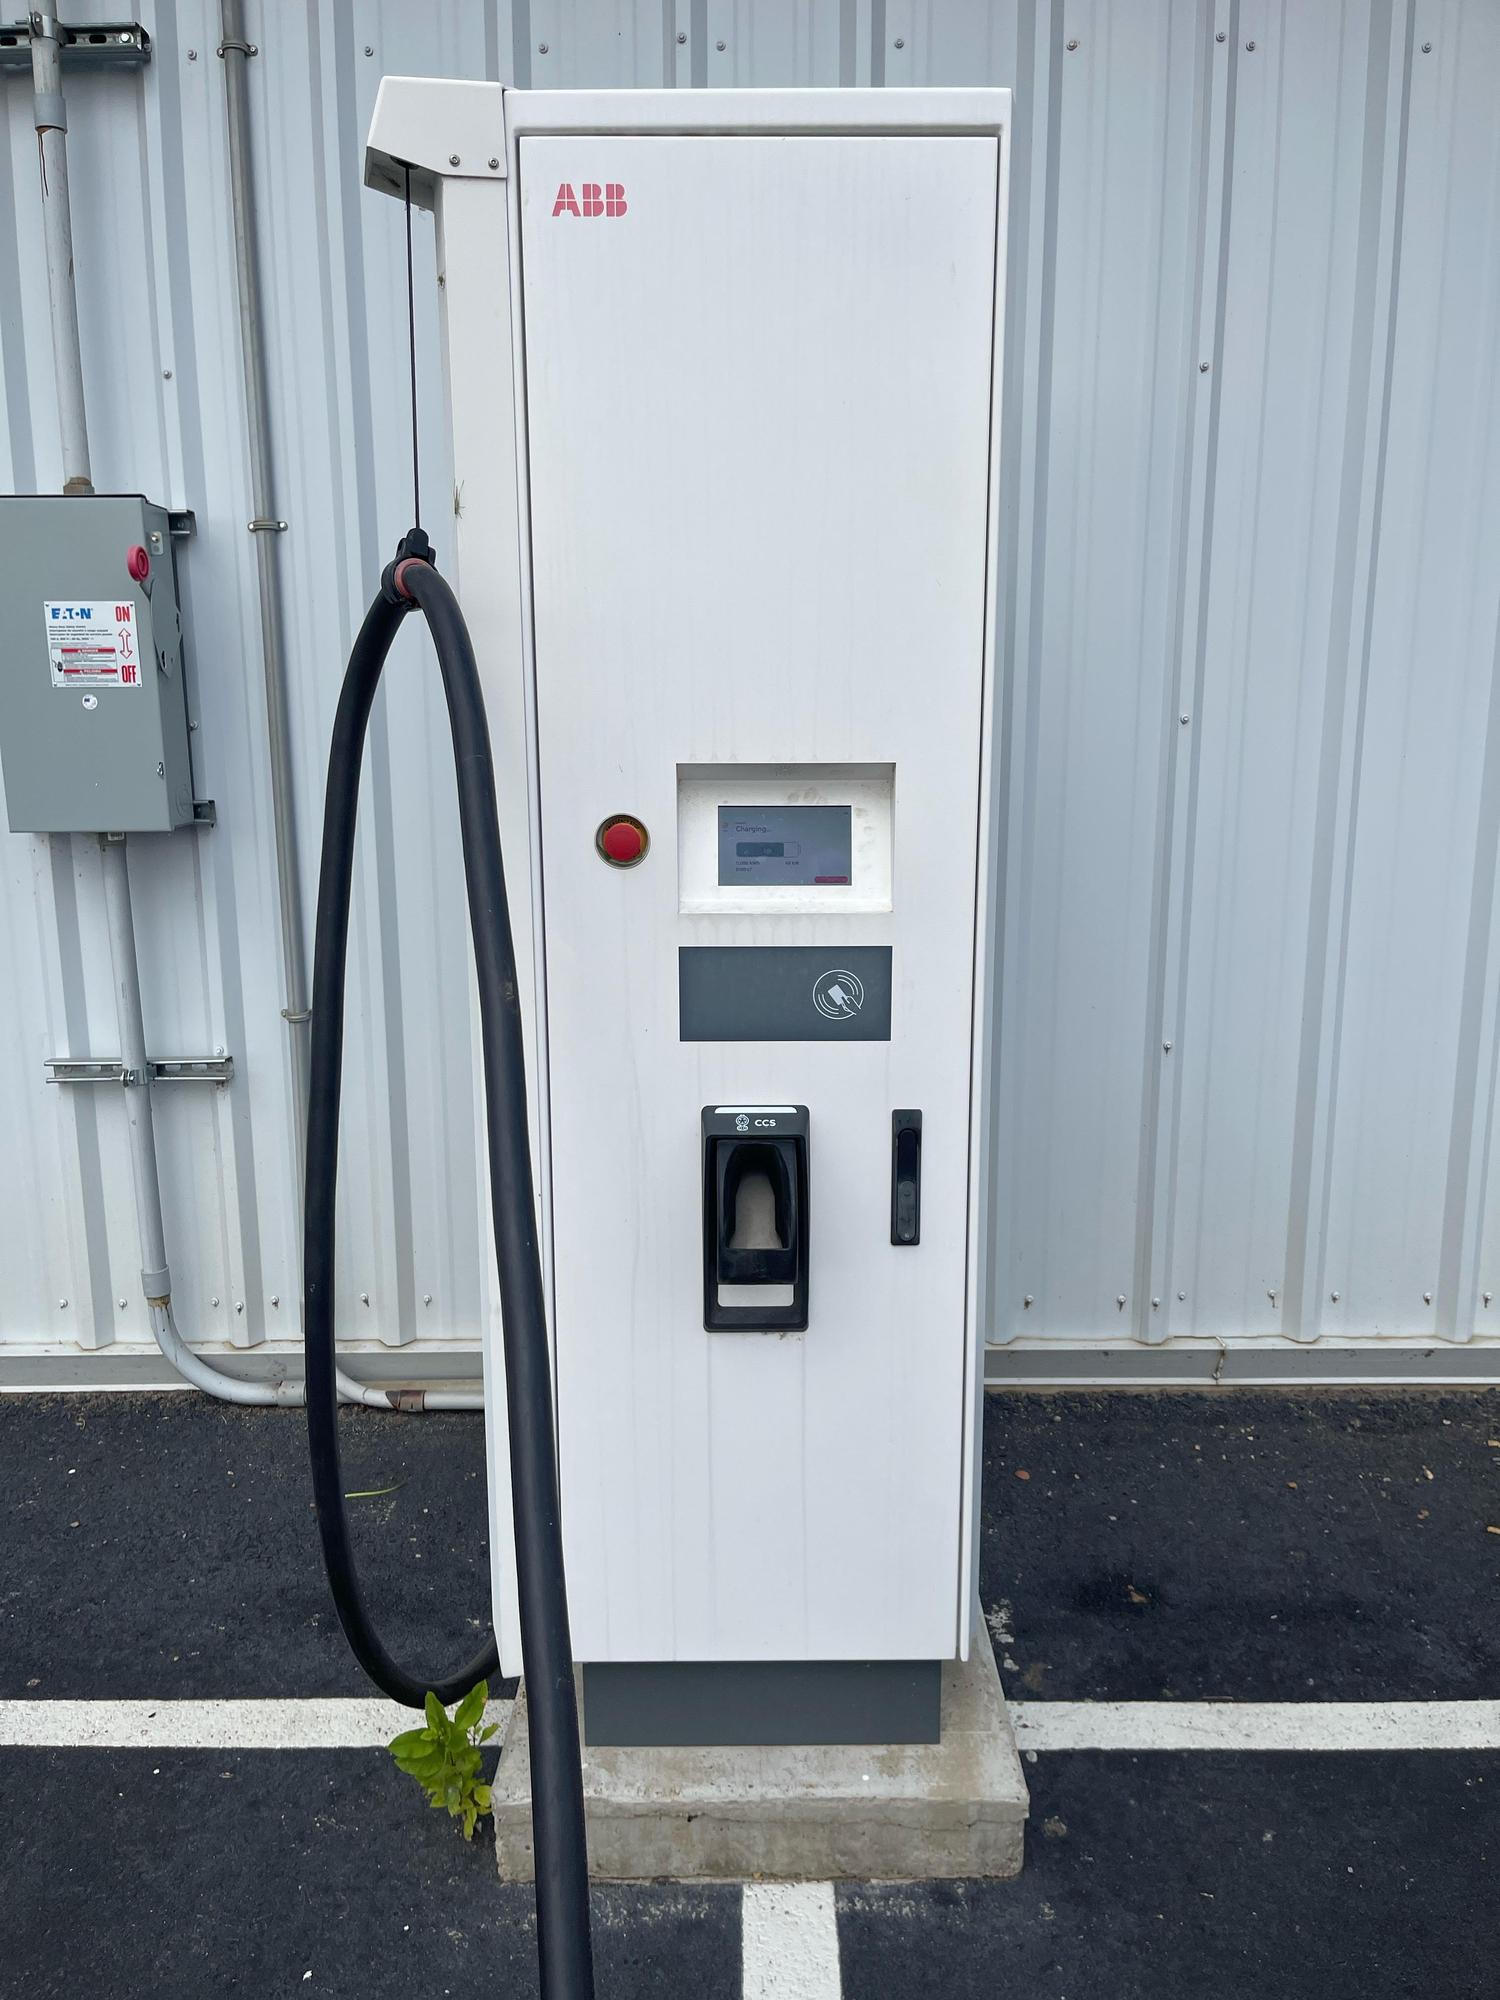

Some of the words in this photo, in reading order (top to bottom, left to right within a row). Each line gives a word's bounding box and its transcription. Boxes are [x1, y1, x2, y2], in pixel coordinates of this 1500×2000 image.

[552, 183, 628, 217] ABB
[115, 606, 131, 622] ON
[121, 665, 136, 683] OFF
[754, 1119, 776, 1127] CCS
